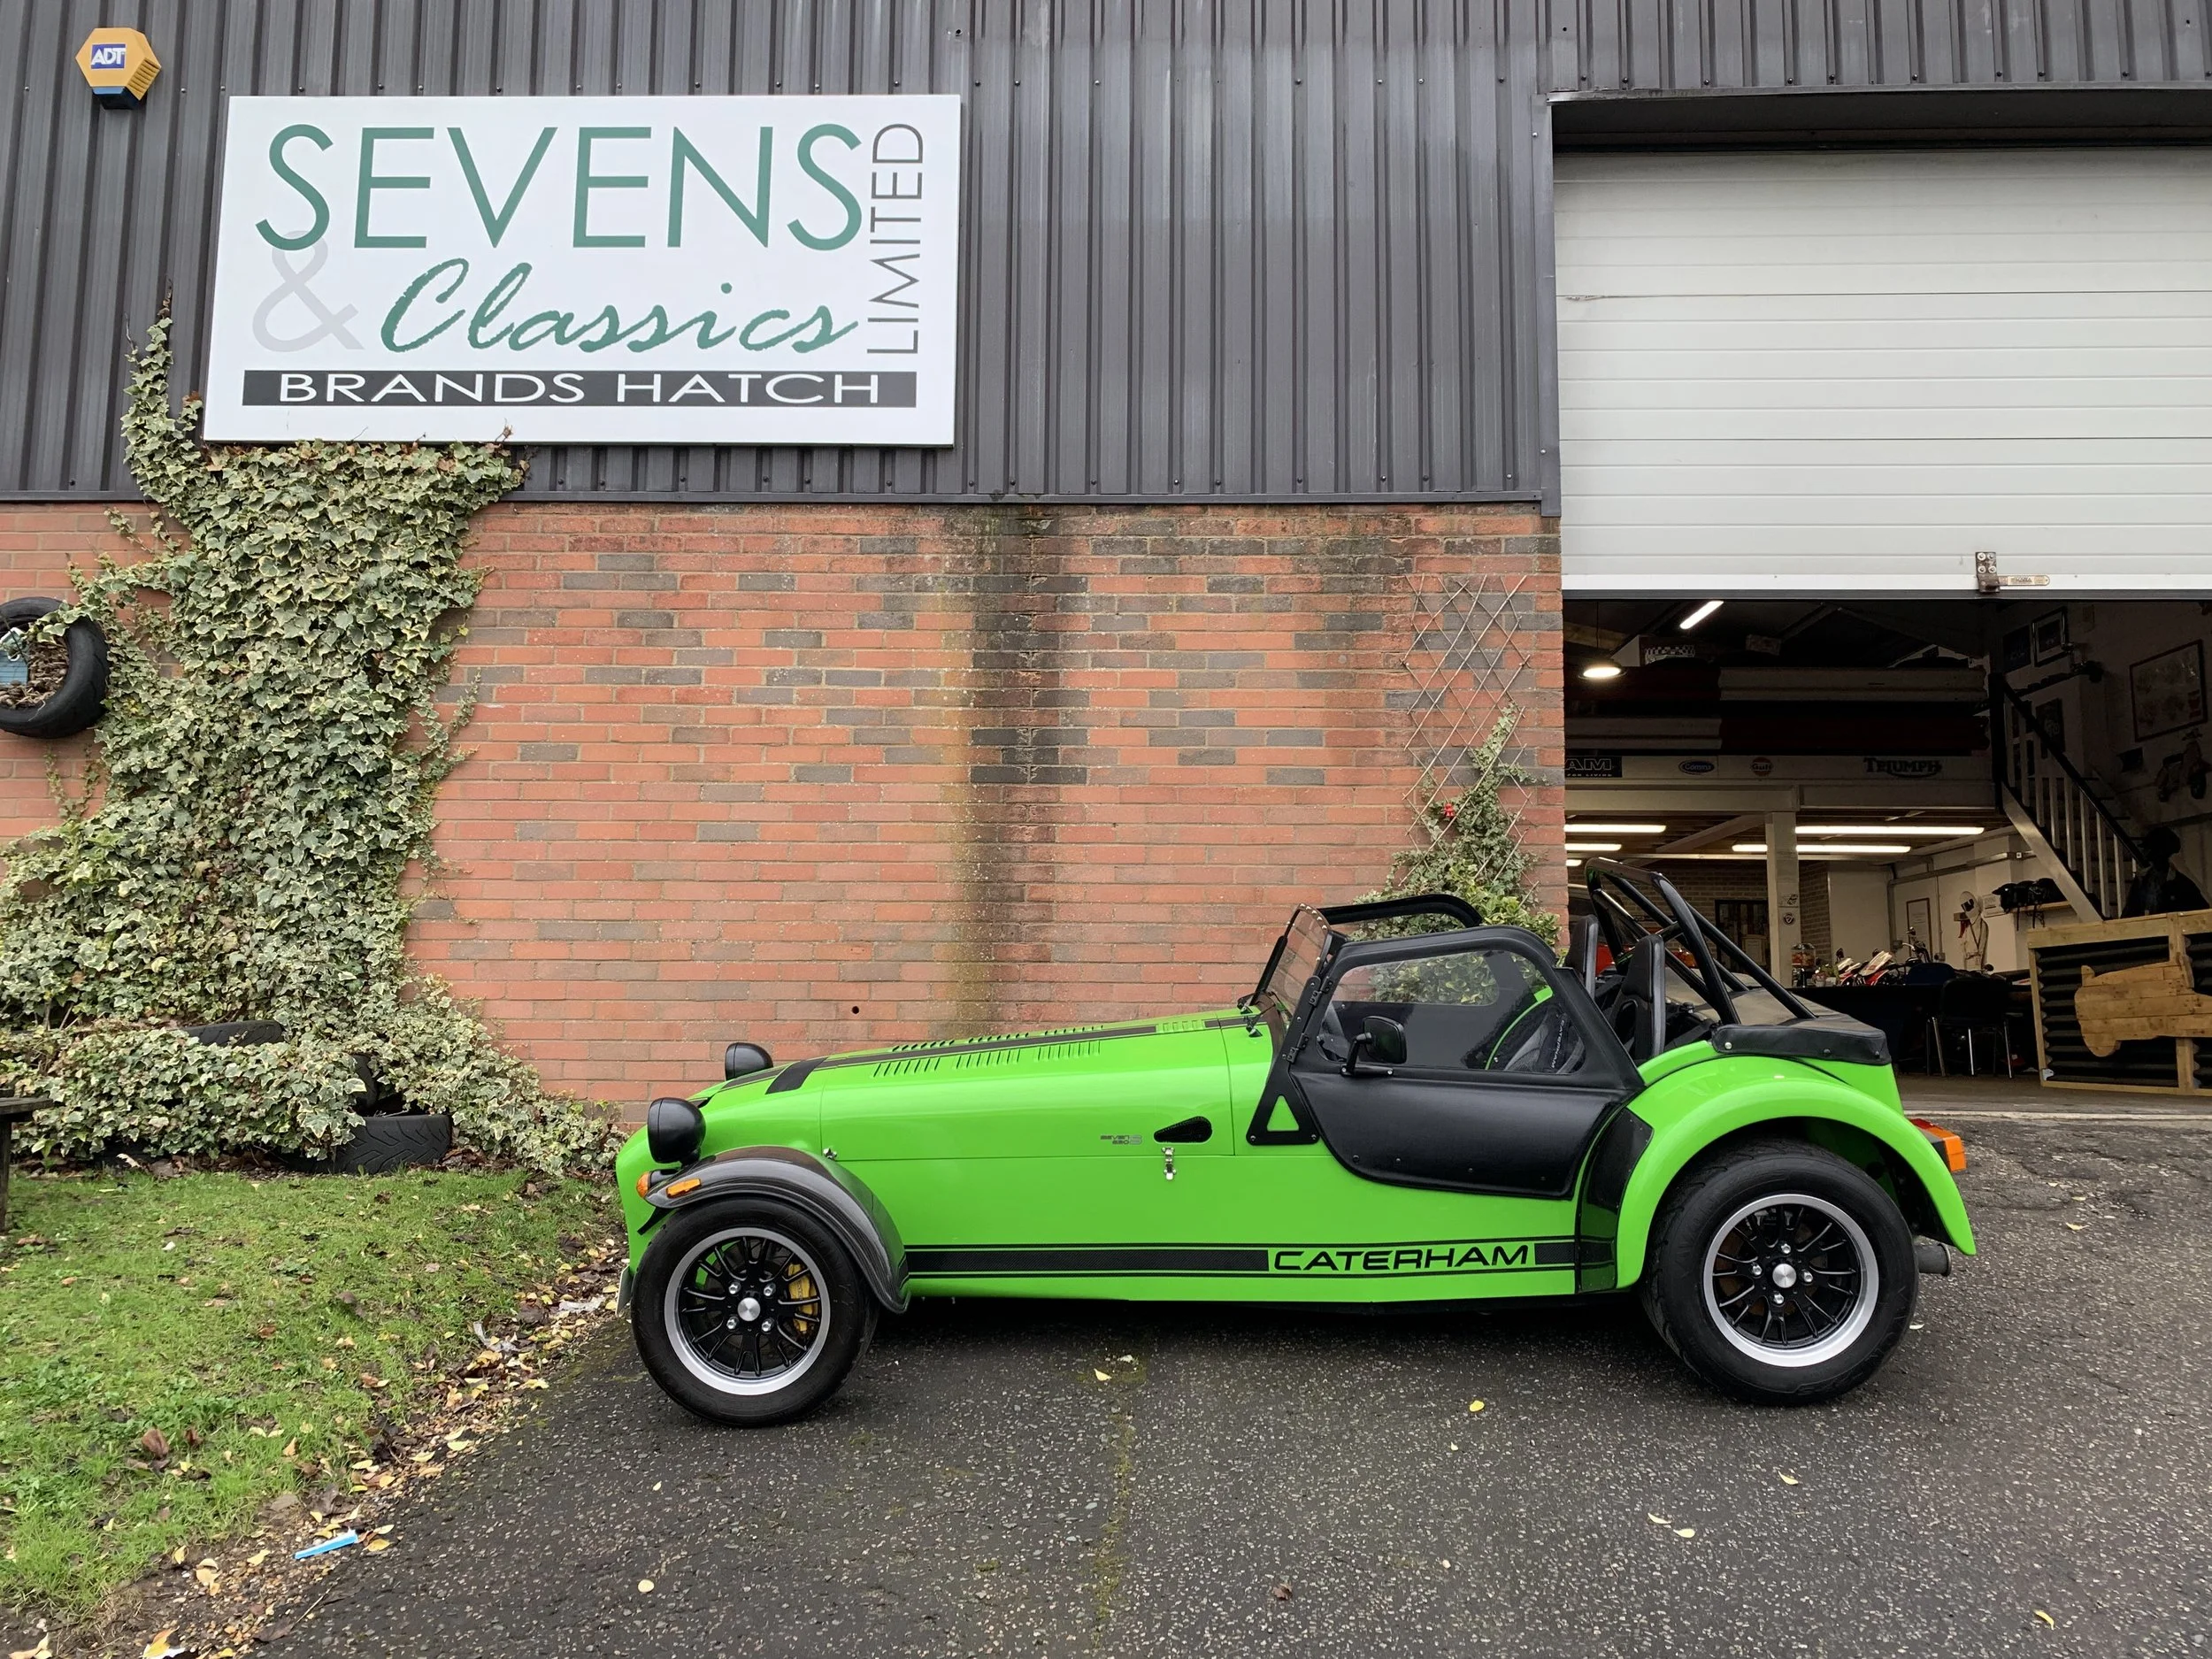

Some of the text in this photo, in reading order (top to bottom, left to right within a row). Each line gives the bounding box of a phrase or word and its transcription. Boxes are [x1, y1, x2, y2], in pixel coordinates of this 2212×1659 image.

[91, 47, 127, 65] ADT
[255, 123, 863, 251] SEVENS
[866, 122, 924, 355] LIMITED
[251, 230, 860, 354] & Classics
[280, 373, 879, 403] BRANDS HATCH
[1683, 762, 1712, 771] Comma
[1273, 1244, 1529, 1271] CATERHAM
